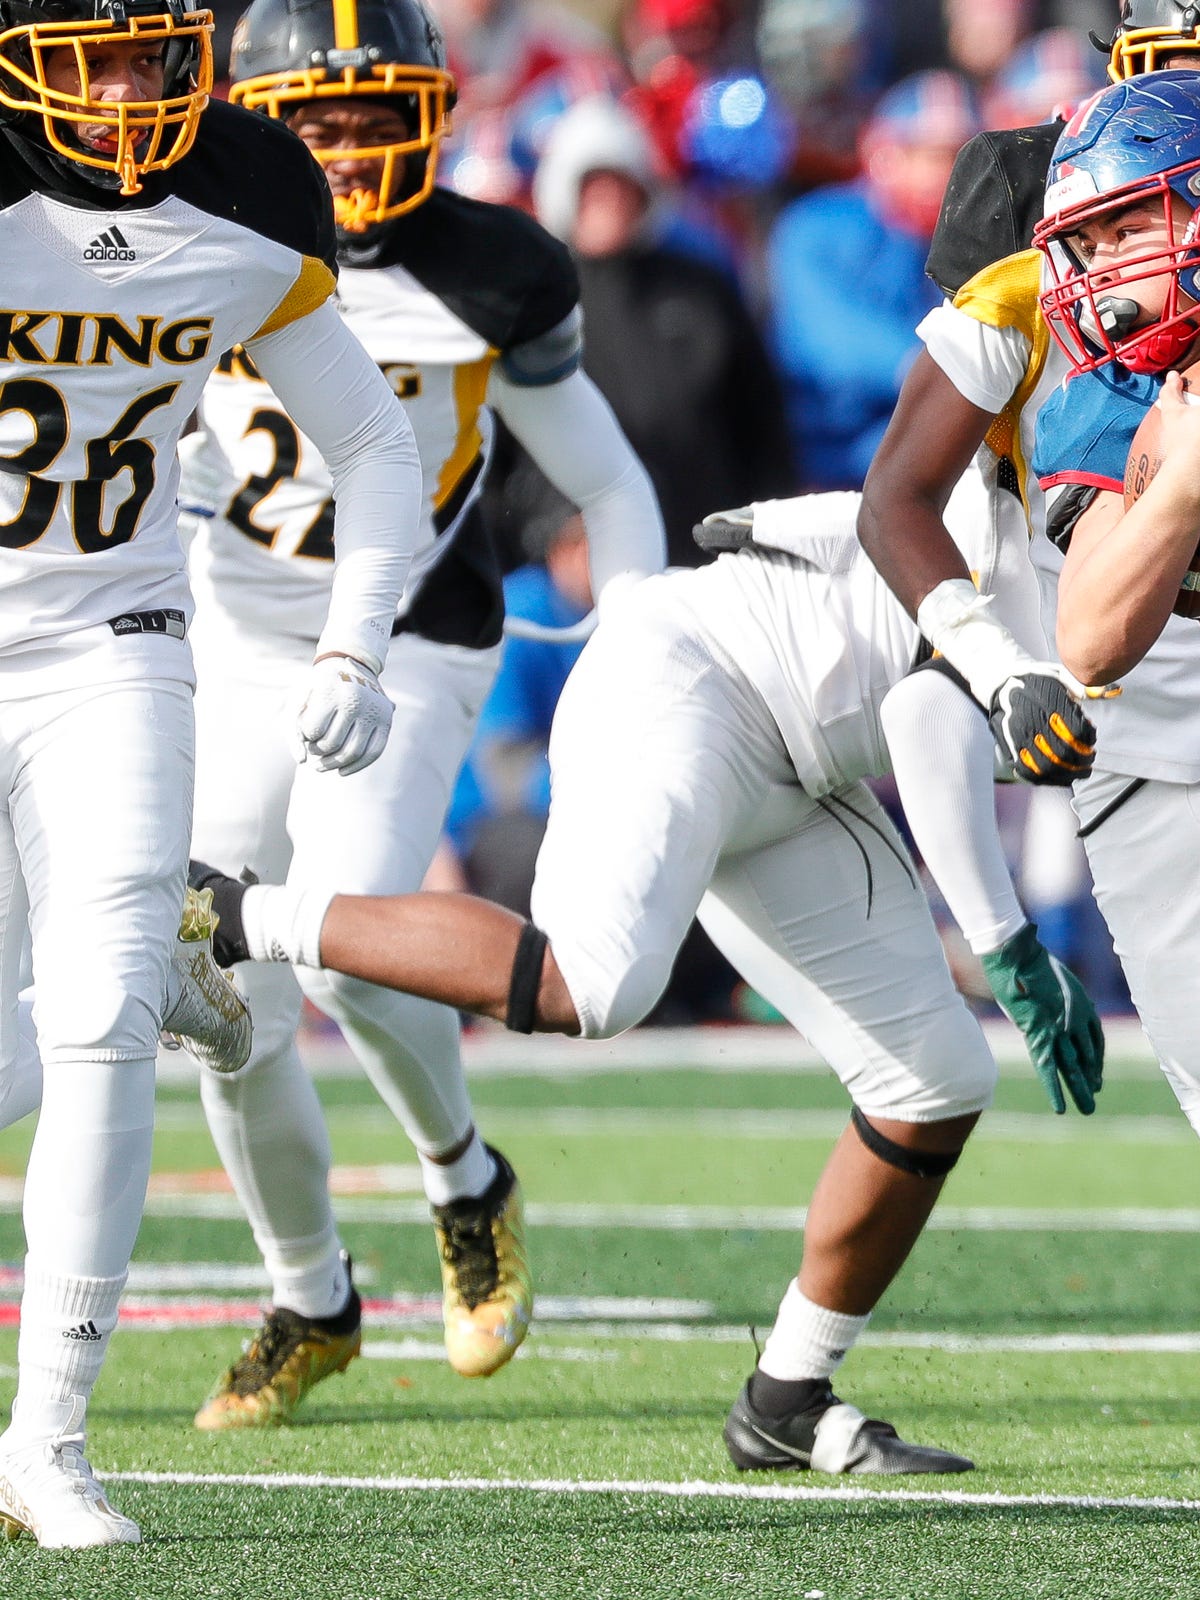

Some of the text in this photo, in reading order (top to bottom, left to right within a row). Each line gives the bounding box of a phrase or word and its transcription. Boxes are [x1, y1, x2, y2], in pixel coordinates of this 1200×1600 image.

[83, 245, 136, 261] adidas
[0, 309, 215, 368] KING
[0, 376, 183, 554] 36
[1134, 453, 1149, 501] GS
[62, 1330, 102, 1341] adidas
